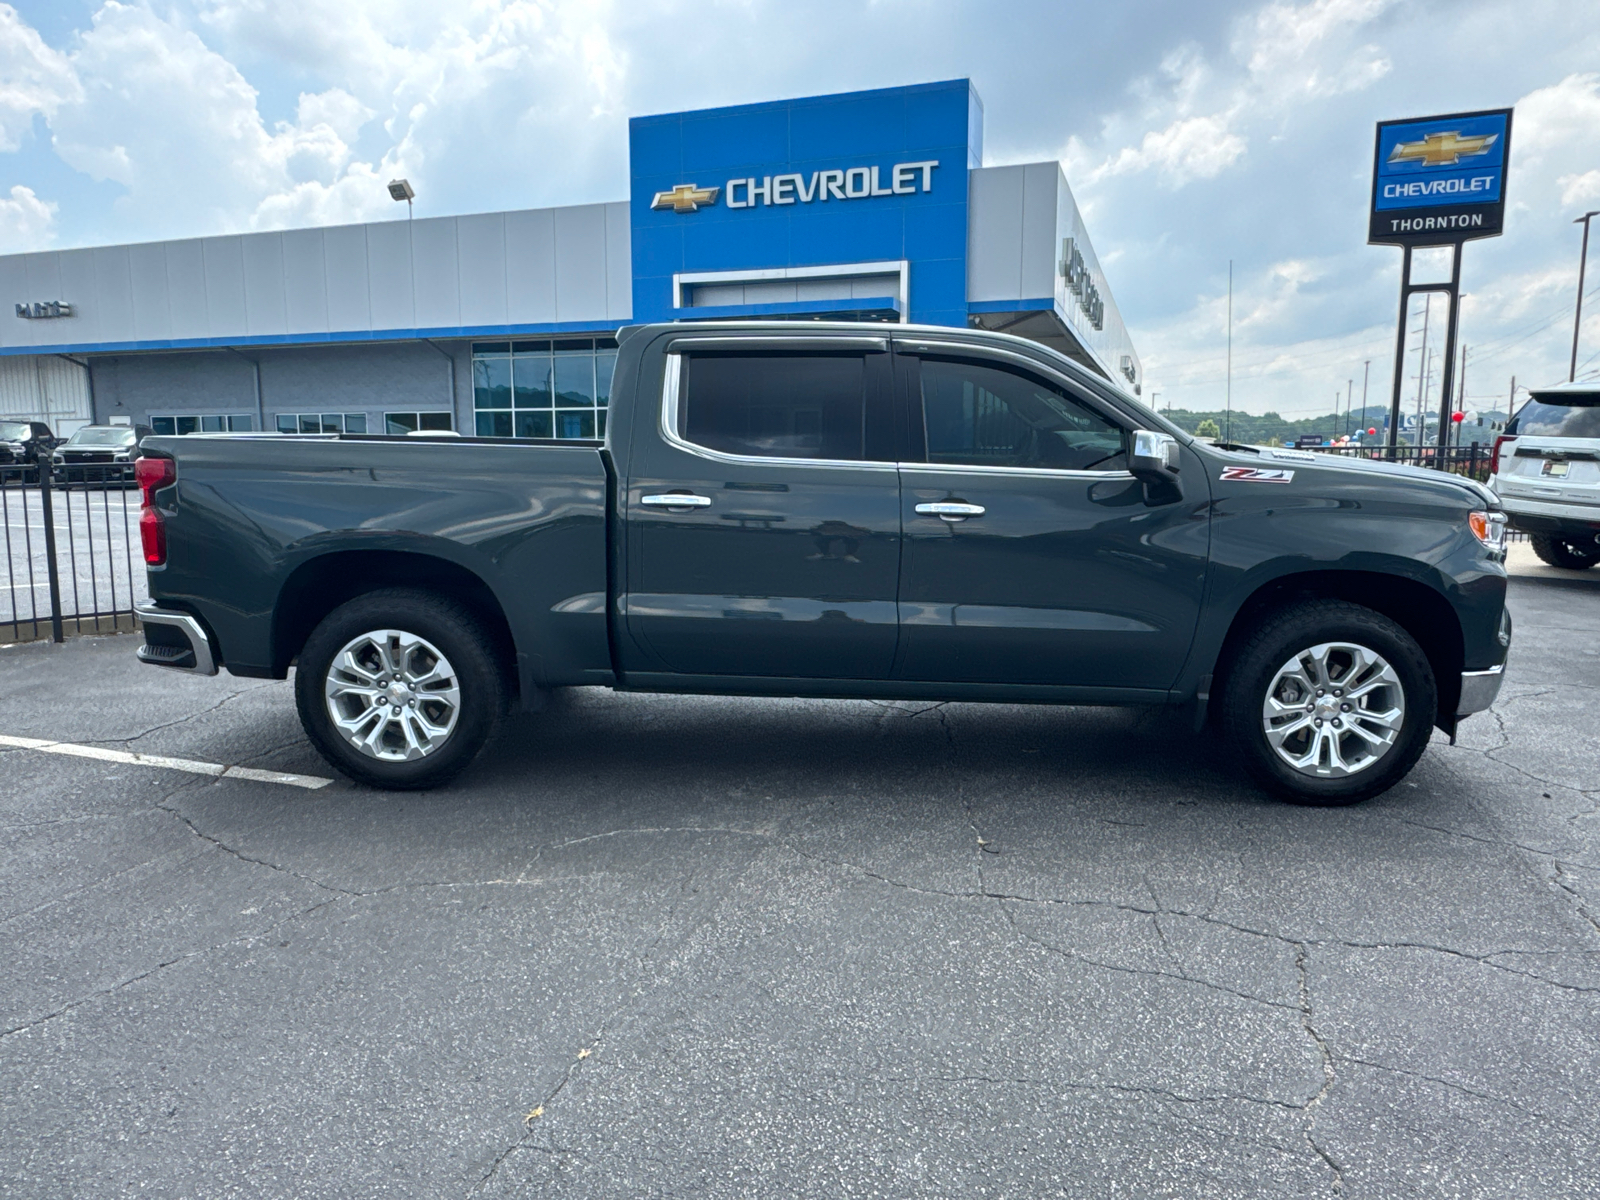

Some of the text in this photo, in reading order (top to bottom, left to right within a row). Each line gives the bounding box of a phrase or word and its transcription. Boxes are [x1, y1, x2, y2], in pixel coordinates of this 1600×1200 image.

[726, 160, 939, 208] CHEVROLET
[1383, 175, 1495, 198] CHEVROLET
[1391, 213, 1483, 232] THORNTON
[15, 300, 65, 318] PARTS
[1219, 466, 1295, 483] Z71
